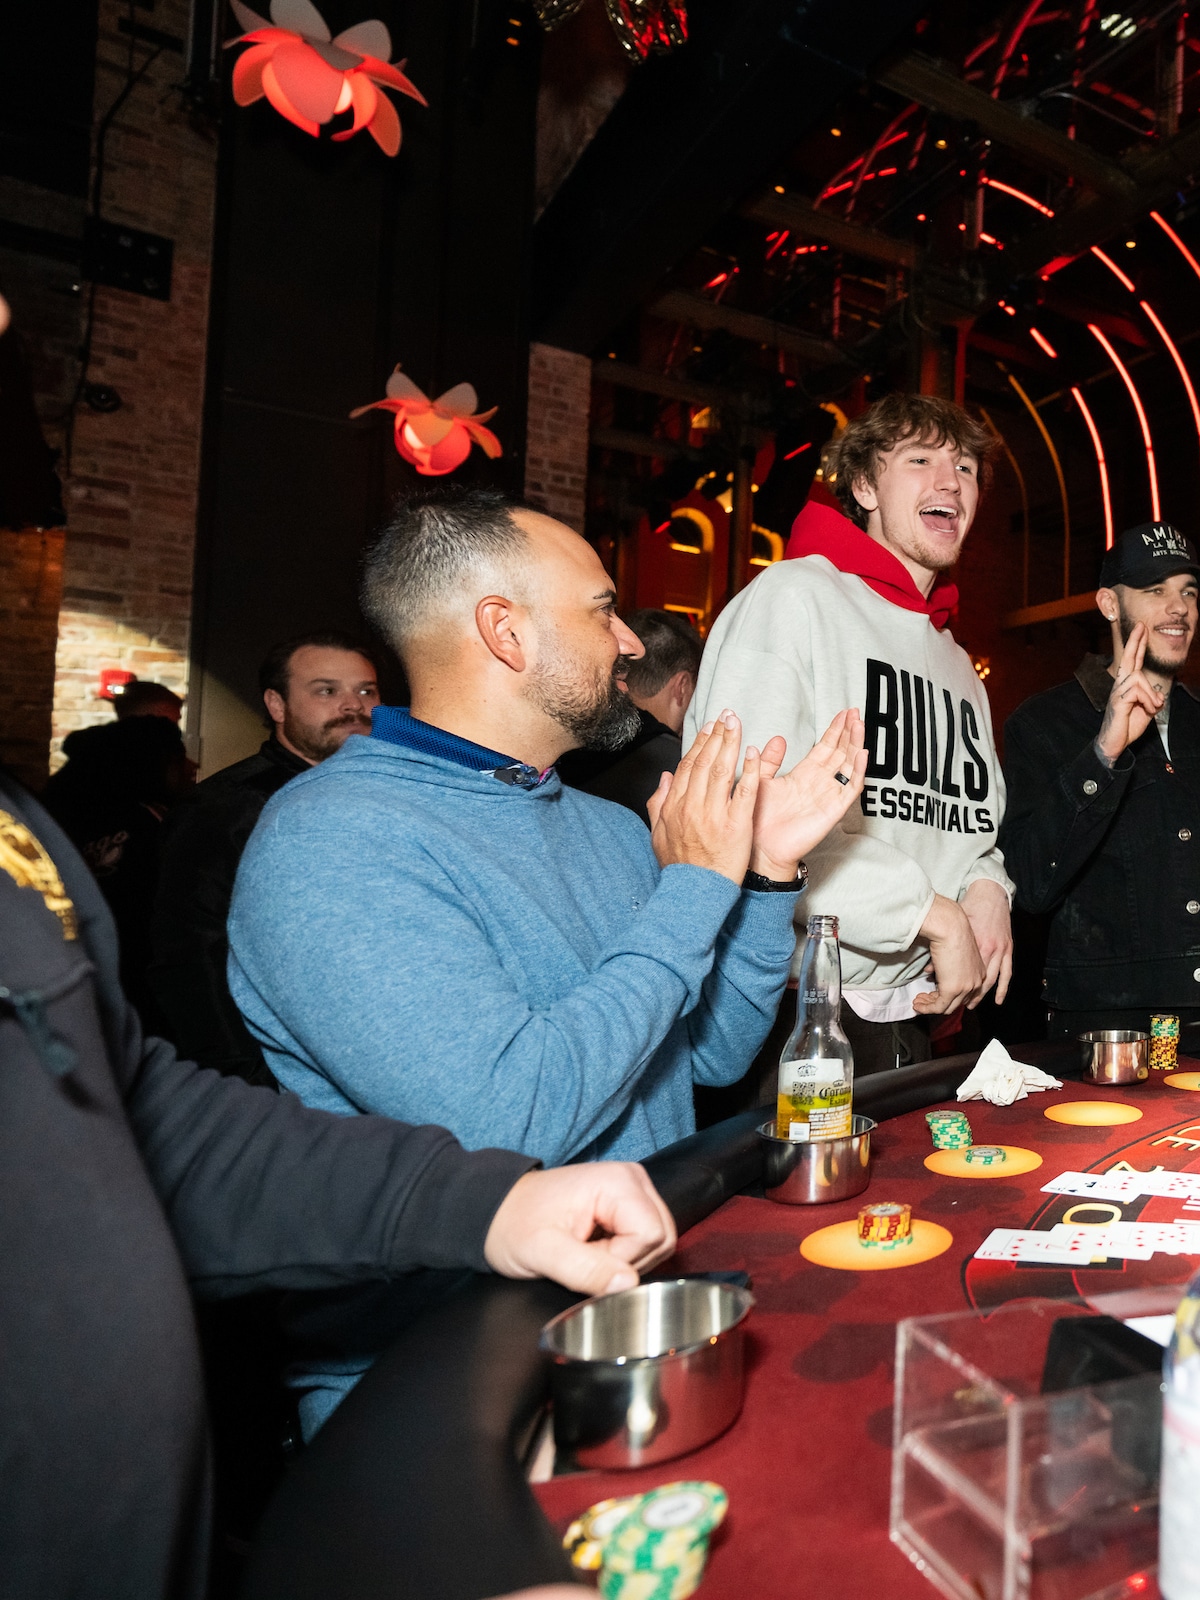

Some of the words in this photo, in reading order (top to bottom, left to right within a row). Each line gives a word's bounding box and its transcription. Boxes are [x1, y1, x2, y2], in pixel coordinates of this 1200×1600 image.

[1141, 526, 1188, 547] AMIRI
[864, 658, 989, 802] BULLS
[861, 784, 995, 834] ESSENTIALS
